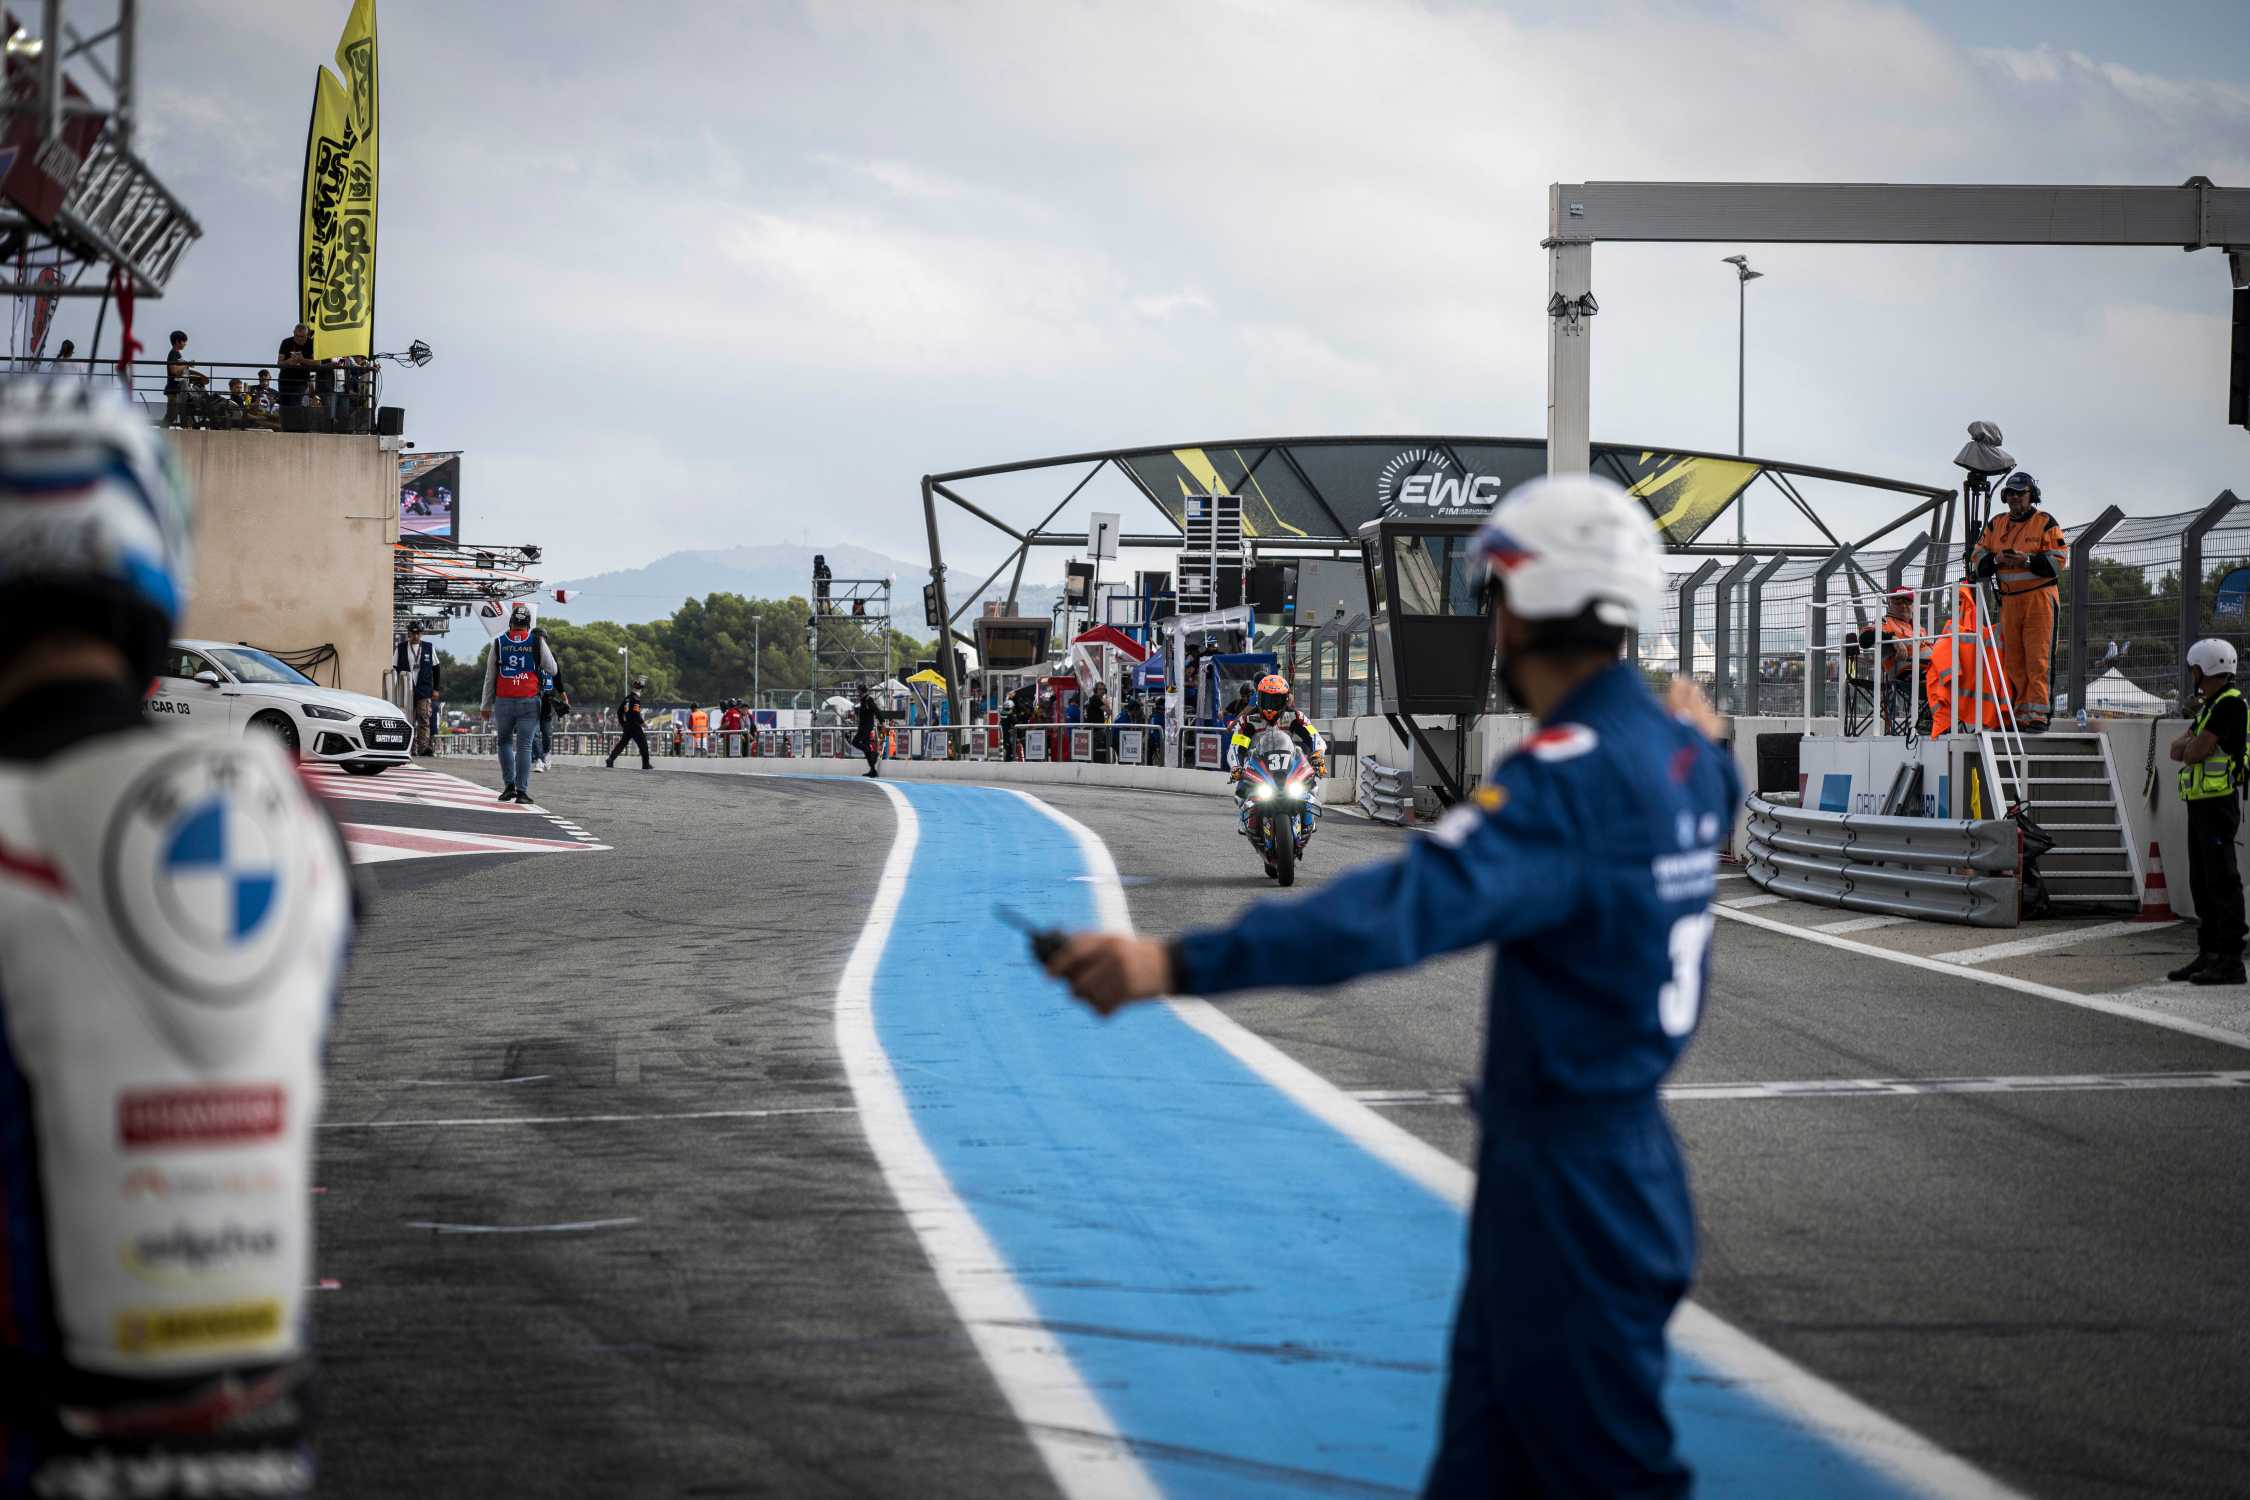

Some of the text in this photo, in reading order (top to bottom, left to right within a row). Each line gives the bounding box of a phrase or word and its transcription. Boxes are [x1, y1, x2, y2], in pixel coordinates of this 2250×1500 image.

[1400, 472, 1501, 507] EWC
[1438, 507, 1459, 515] FIM
[509, 655, 525, 668] 81
[152, 700, 175, 714] CAR
[176, 702, 190, 715] 03
[1268, 753, 1291, 770] 37
